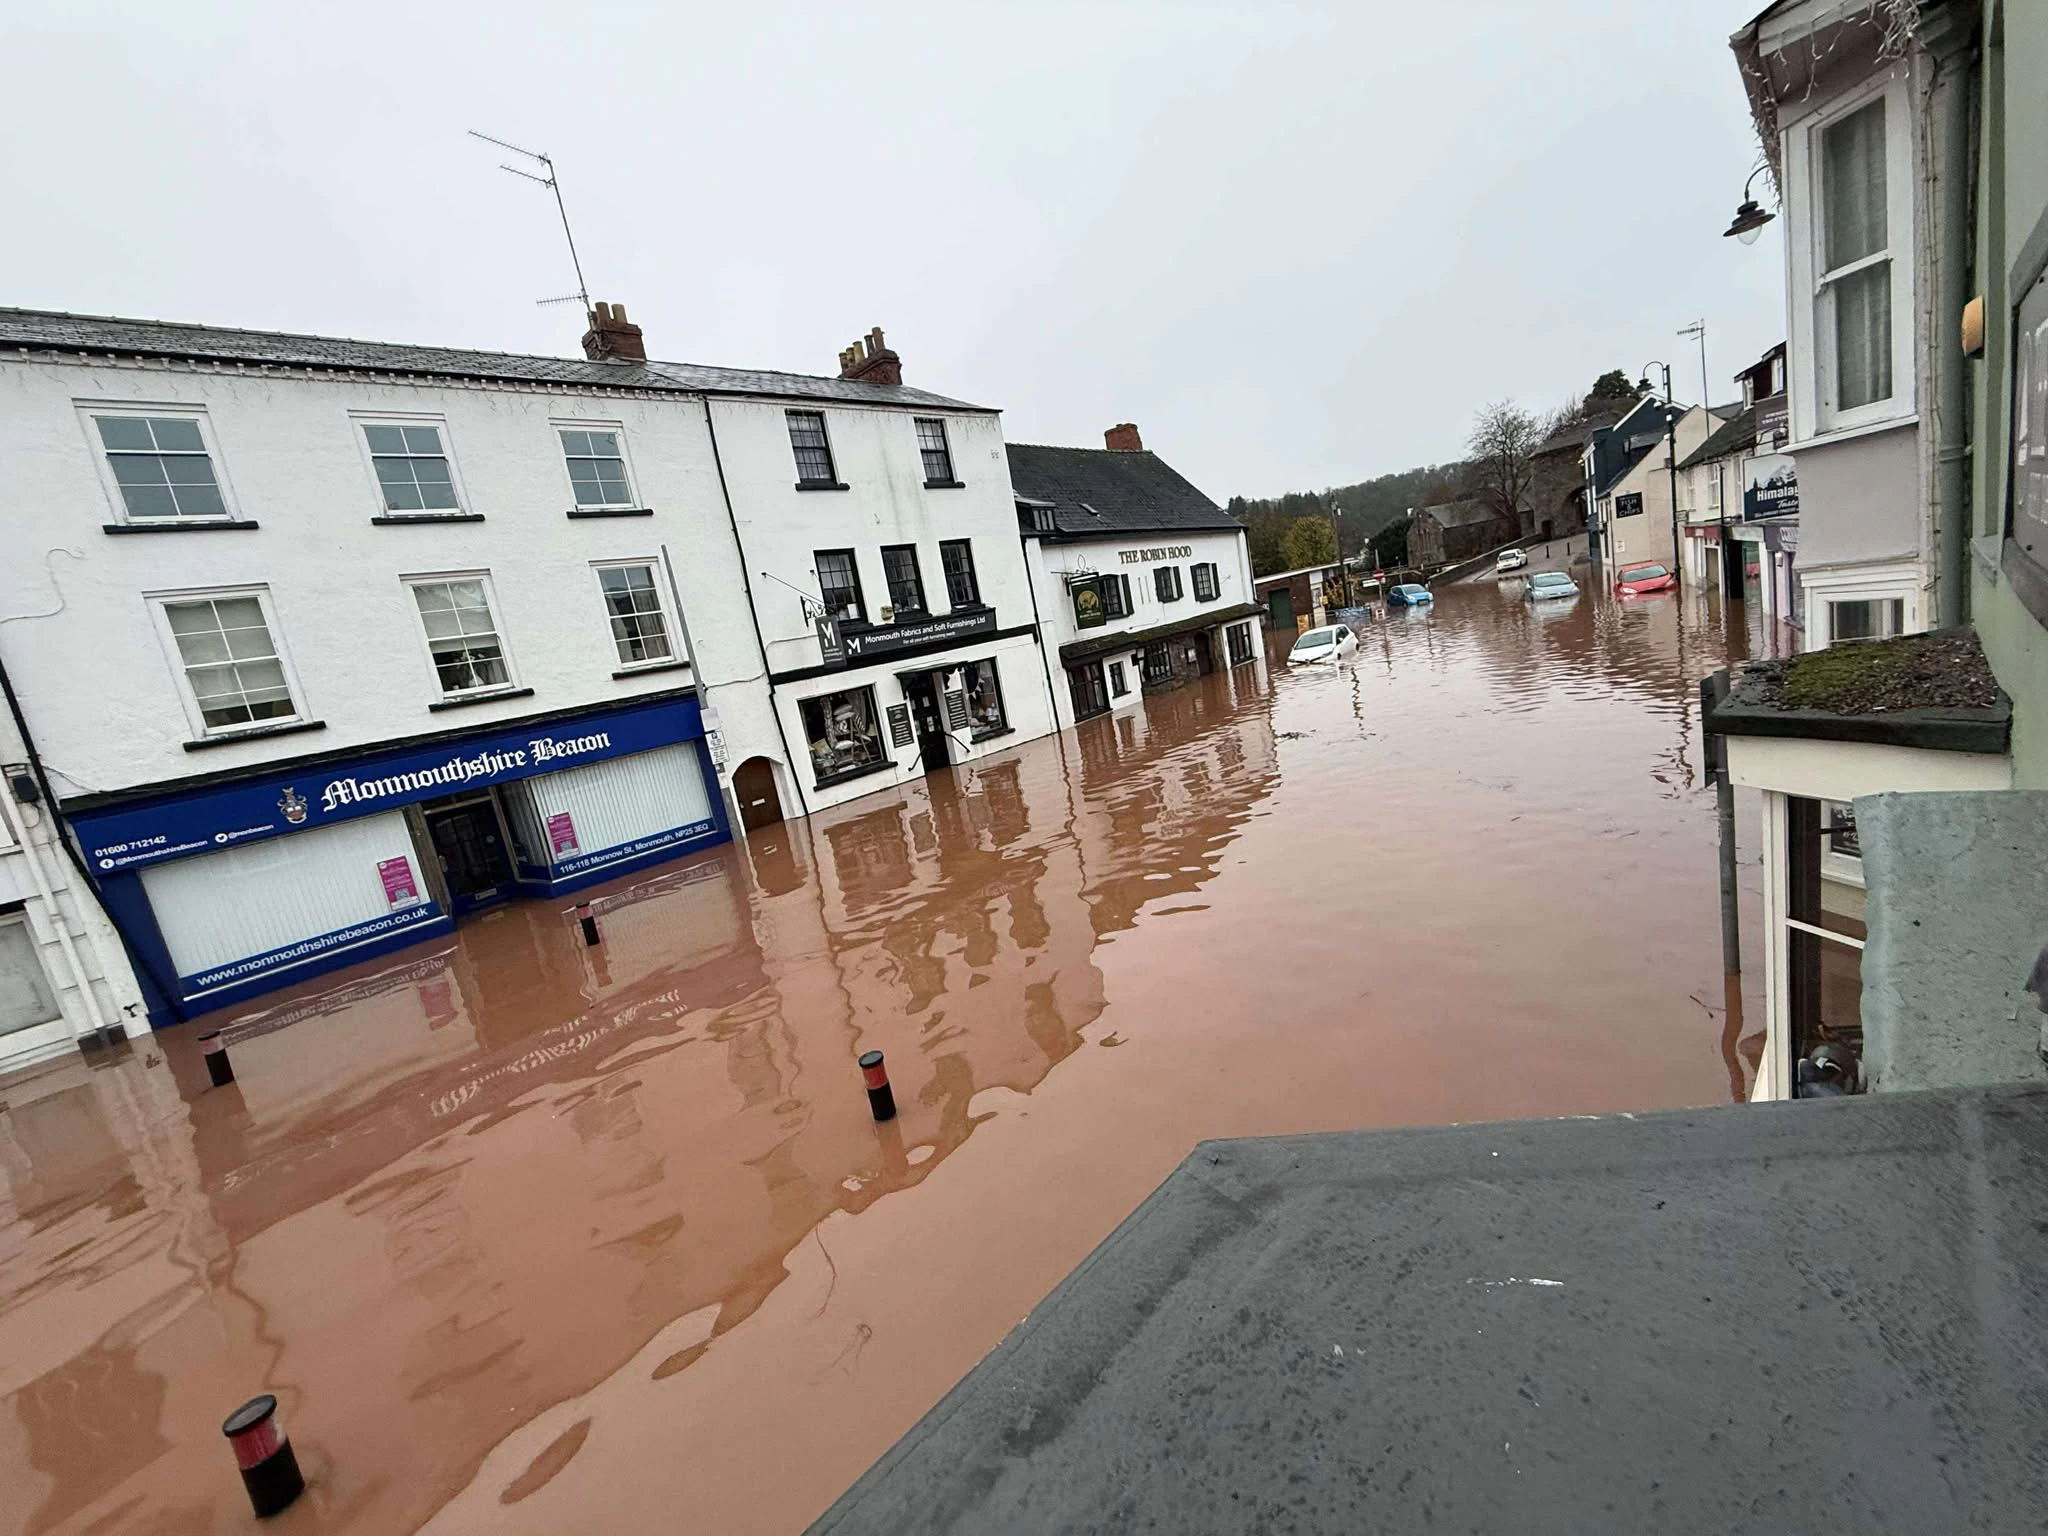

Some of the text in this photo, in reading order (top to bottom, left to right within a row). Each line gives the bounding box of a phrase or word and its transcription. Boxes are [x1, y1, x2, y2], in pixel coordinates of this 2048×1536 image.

[1118, 546, 1192, 564] THE ROBIN HOOD
[821, 621, 836, 647] M
[865, 616, 986, 644] Monmouth Fabrics and Soft Furnishings Ltd
[846, 638, 861, 655] M
[321, 732, 610, 812] Monmouthshire Beacon
[228, 824, 274, 839] @monbeacon
[95, 835, 167, 857] 01600 712142
[115, 839, 208, 866] @MonmouthshireBeacon
[560, 823, 709, 873] 116-118 Monnow St, Monmouth, NP25 3EQ
[196, 907, 428, 986] www.monmouthshirebeacon.co.uk
